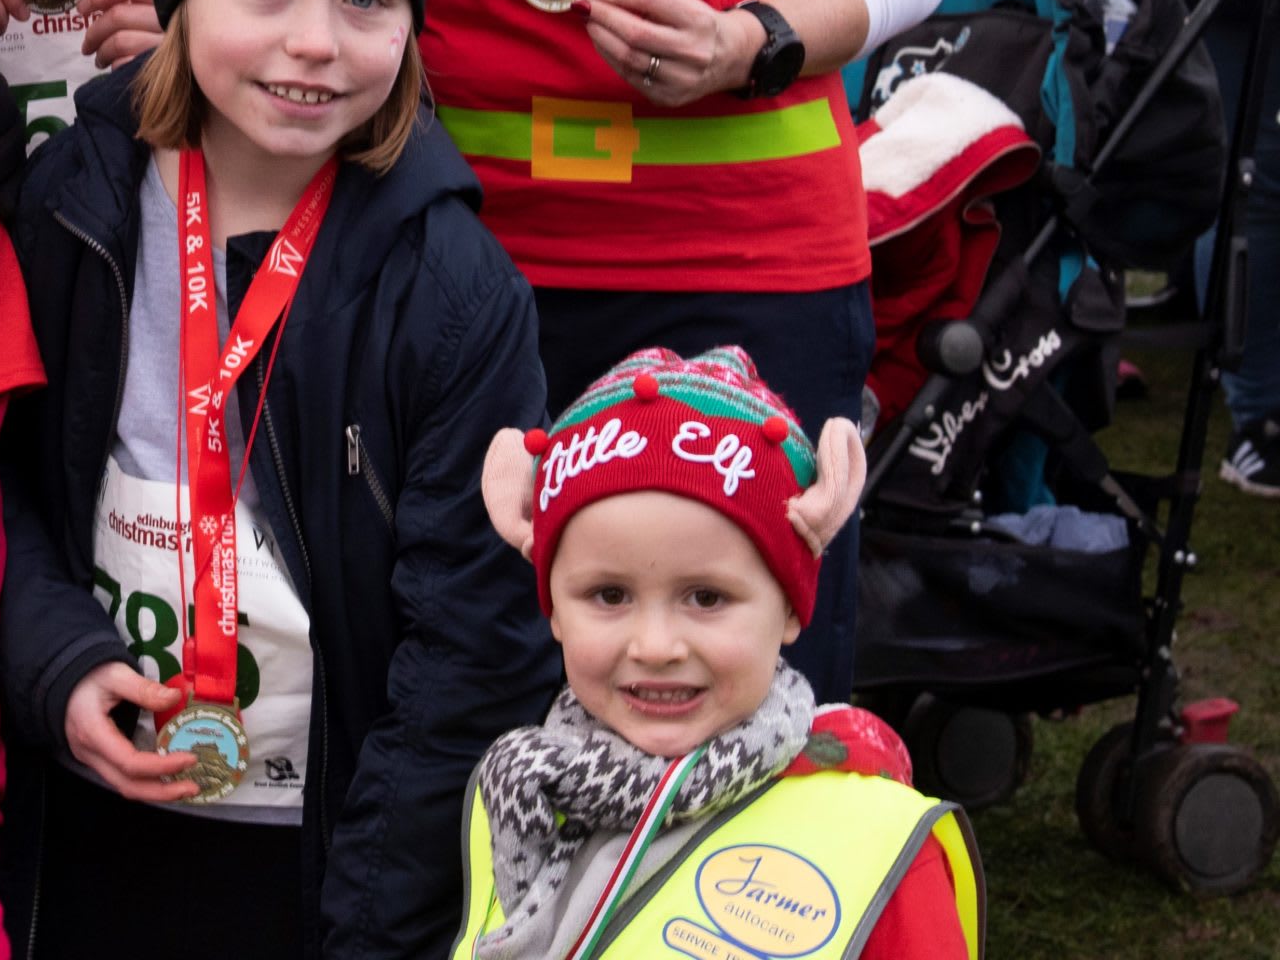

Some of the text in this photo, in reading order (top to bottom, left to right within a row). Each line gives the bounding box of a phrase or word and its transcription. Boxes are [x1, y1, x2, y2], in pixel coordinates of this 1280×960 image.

[185, 191, 208, 314] 5K & 10K
[207, 418, 222, 453] 5K
[219, 334, 255, 381] 10K
[538, 417, 756, 513] Little Elf
[108, 508, 179, 552] christmas
[217, 548, 236, 637] christmas
[671, 925, 720, 957] SERVICE
[722, 900, 797, 945] autocare
